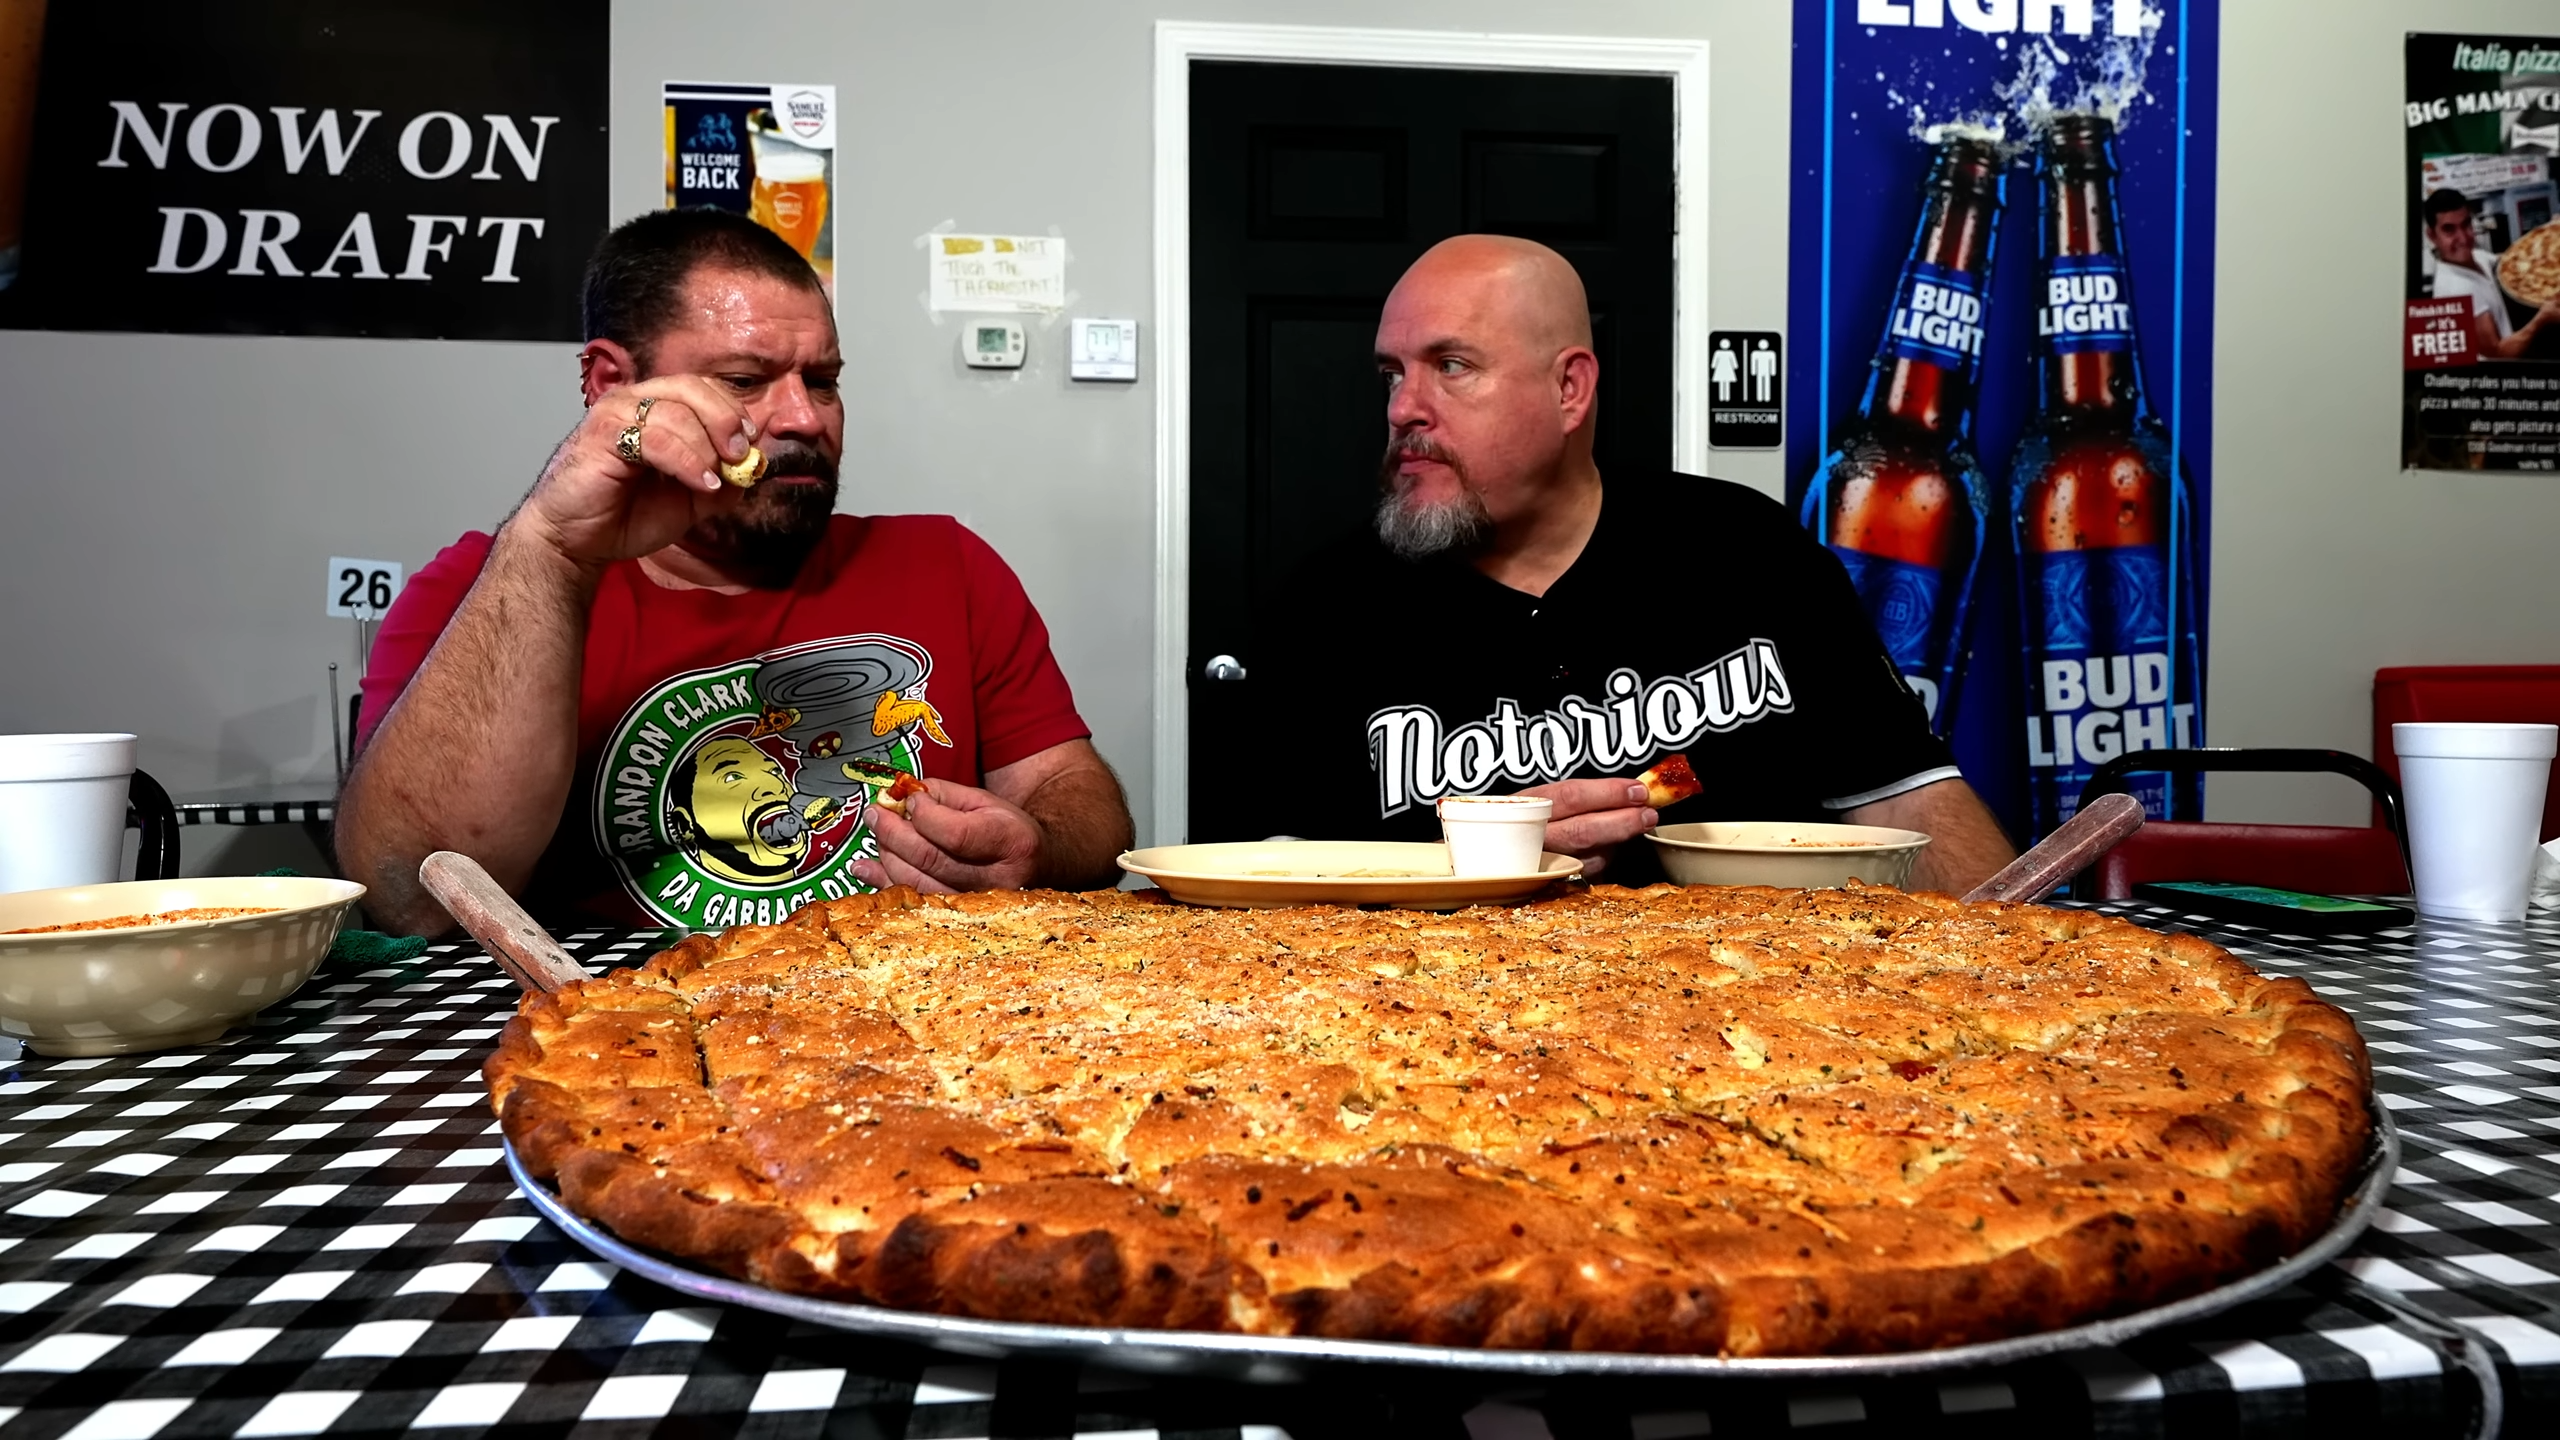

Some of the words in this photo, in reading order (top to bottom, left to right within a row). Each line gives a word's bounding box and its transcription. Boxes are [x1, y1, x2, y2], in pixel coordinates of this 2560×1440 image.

[2453, 41, 2511, 71] Italia
[2512, 43, 2560, 77] pizz
[2406, 97, 2450, 128] BIG
[2455, 90, 2529, 115] MAMA
[97, 100, 383, 176] NOW
[398, 111, 560, 182] ON
[681, 153, 741, 167] WELCOME
[683, 167, 740, 190] BACK
[146, 206, 545, 283] DRAFT
[1911, 283, 1981, 324] BUD
[2048, 275, 2118, 306] BUD
[1892, 308, 1985, 356] LIGHT
[2039, 304, 2130, 336] LIGHT
[2412, 330, 2467, 356] FREE!
[2424, 373, 2471, 391] Challenge
[2501, 378, 2520, 392] you
[2521, 376, 2546, 390] have
[1715, 413, 1778, 424] RESTROOM
[2420, 396, 2449, 411] pizza
[2450, 396, 2482, 410] within
[2498, 398, 2539, 411] minutes
[2541, 399, 2560, 411] and
[2470, 418, 2491, 432] also
[2517, 420, 2554, 435] picture
[338, 568, 391, 610] 26
[2043, 652, 2170, 711] BUD
[1367, 638, 1795, 819] Notorious
[2027, 703, 2195, 767] LIGHT
[614, 721, 673, 854] RANDON
[663, 675, 752, 731] CLARK
[657, 871, 703, 913] DA
